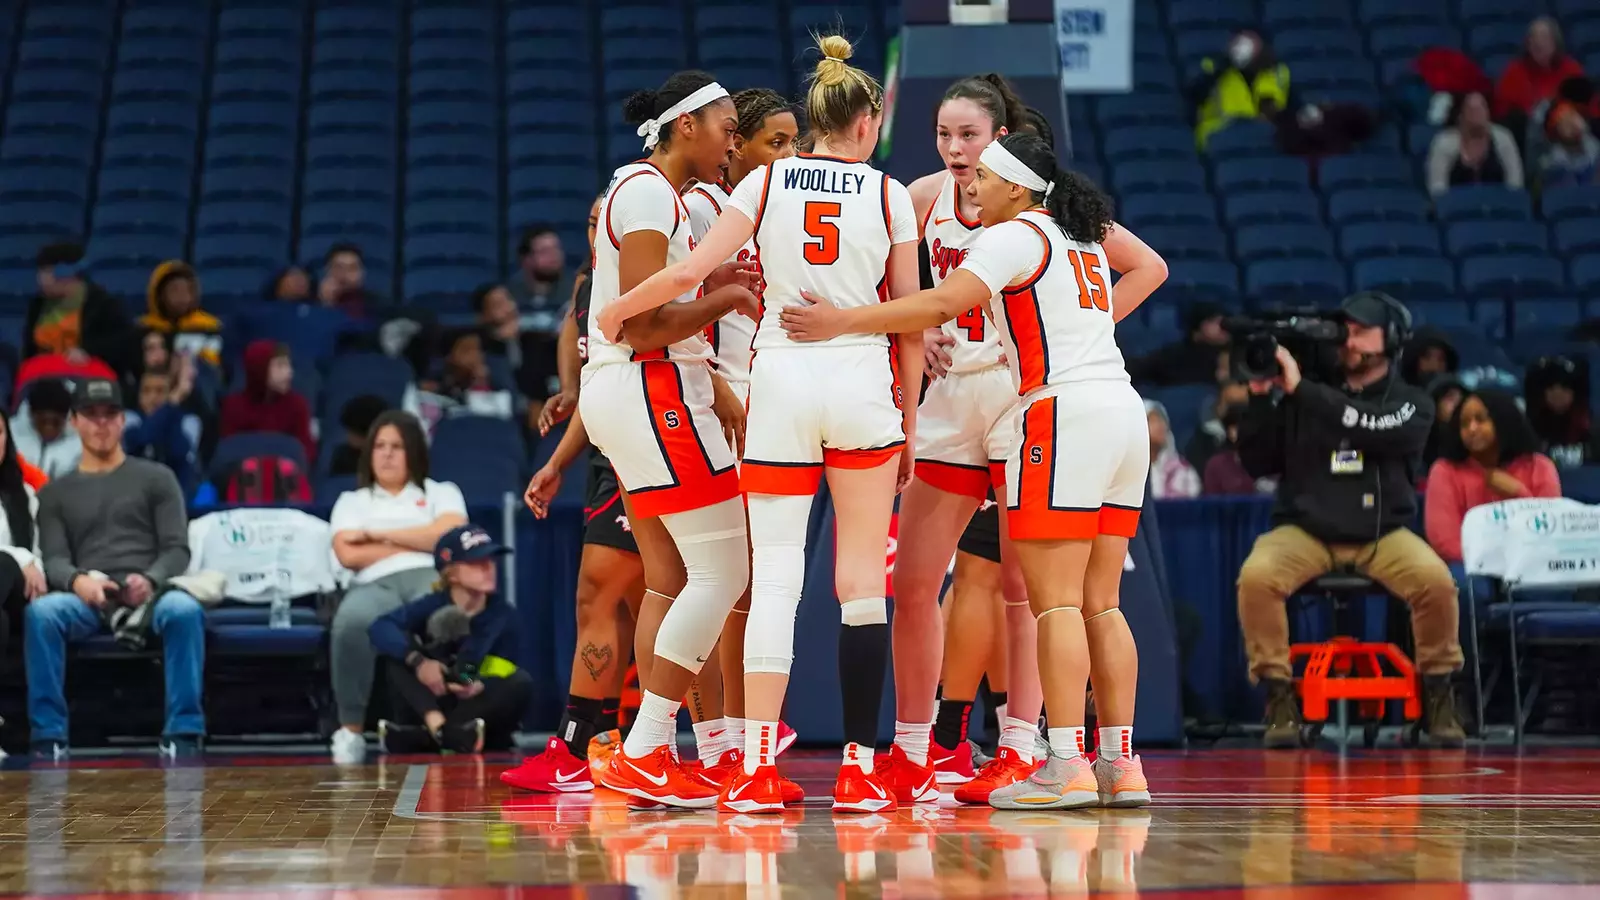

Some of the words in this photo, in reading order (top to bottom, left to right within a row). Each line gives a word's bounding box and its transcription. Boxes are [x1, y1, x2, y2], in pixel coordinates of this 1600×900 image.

[784, 167, 866, 195] WOOLLEY
[803, 200, 842, 266] 5
[1067, 249, 1110, 313] 15
[956, 304, 986, 343] 4
[664, 409, 681, 430] S
[1030, 445, 1044, 465] S
